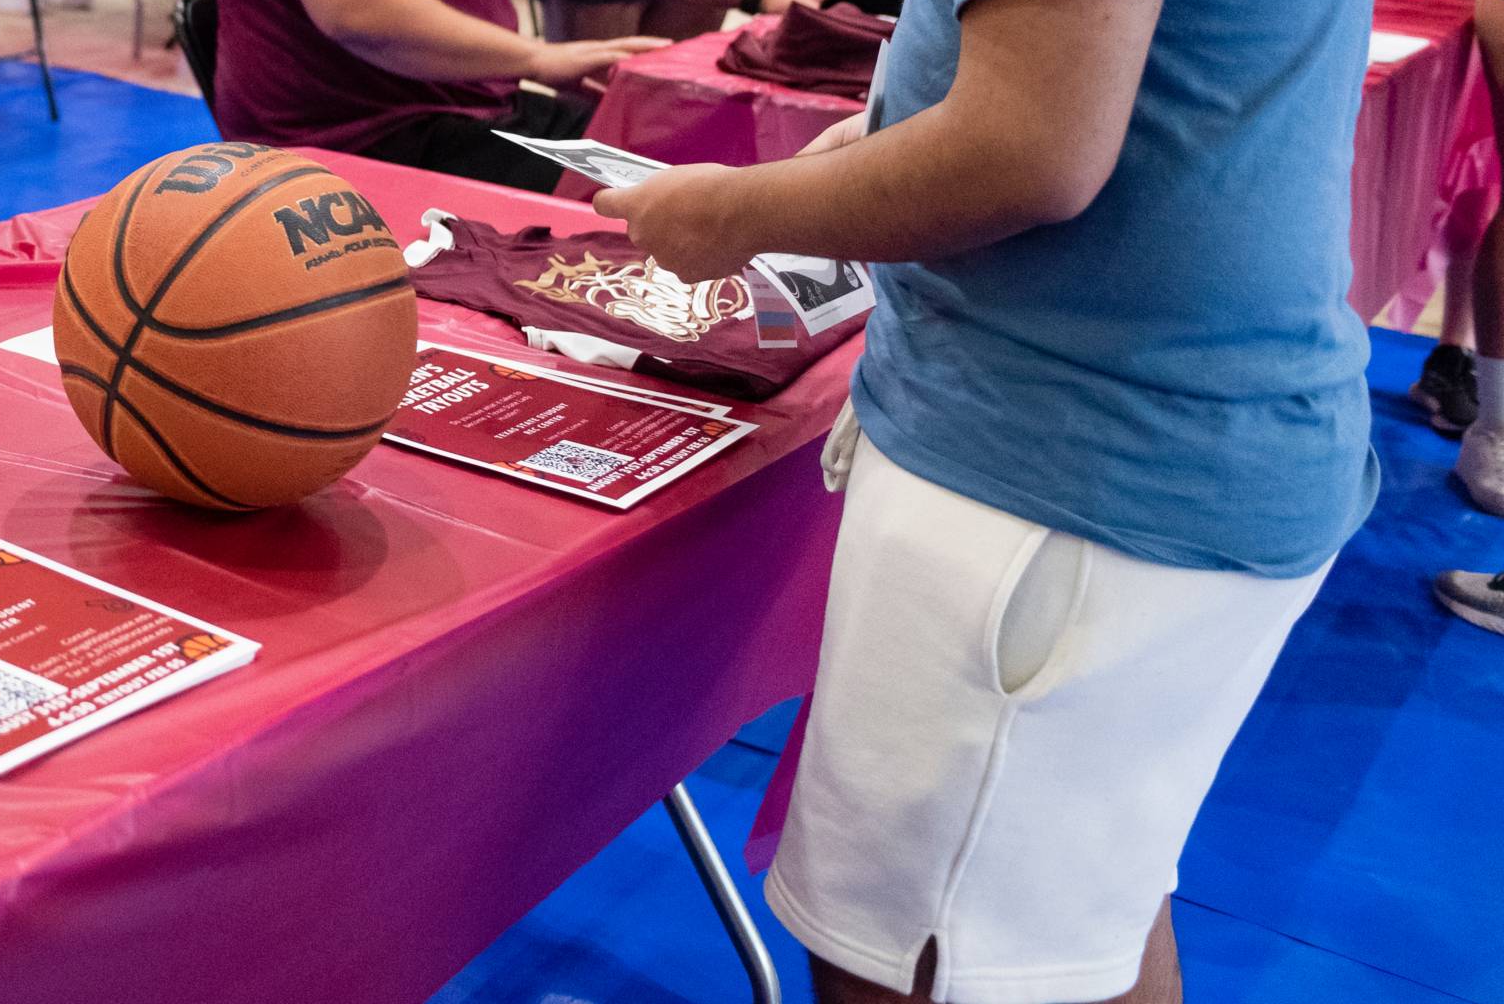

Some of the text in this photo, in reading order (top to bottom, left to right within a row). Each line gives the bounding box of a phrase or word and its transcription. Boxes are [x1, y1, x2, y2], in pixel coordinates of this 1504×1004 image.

[409, 362, 444, 386] EN'S
[398, 367, 477, 409] SKETBALL
[413, 379, 490, 415] TRYOUTS
[536, 403, 568, 419] STUDENT
[586, 469, 625, 492] AUGUST
